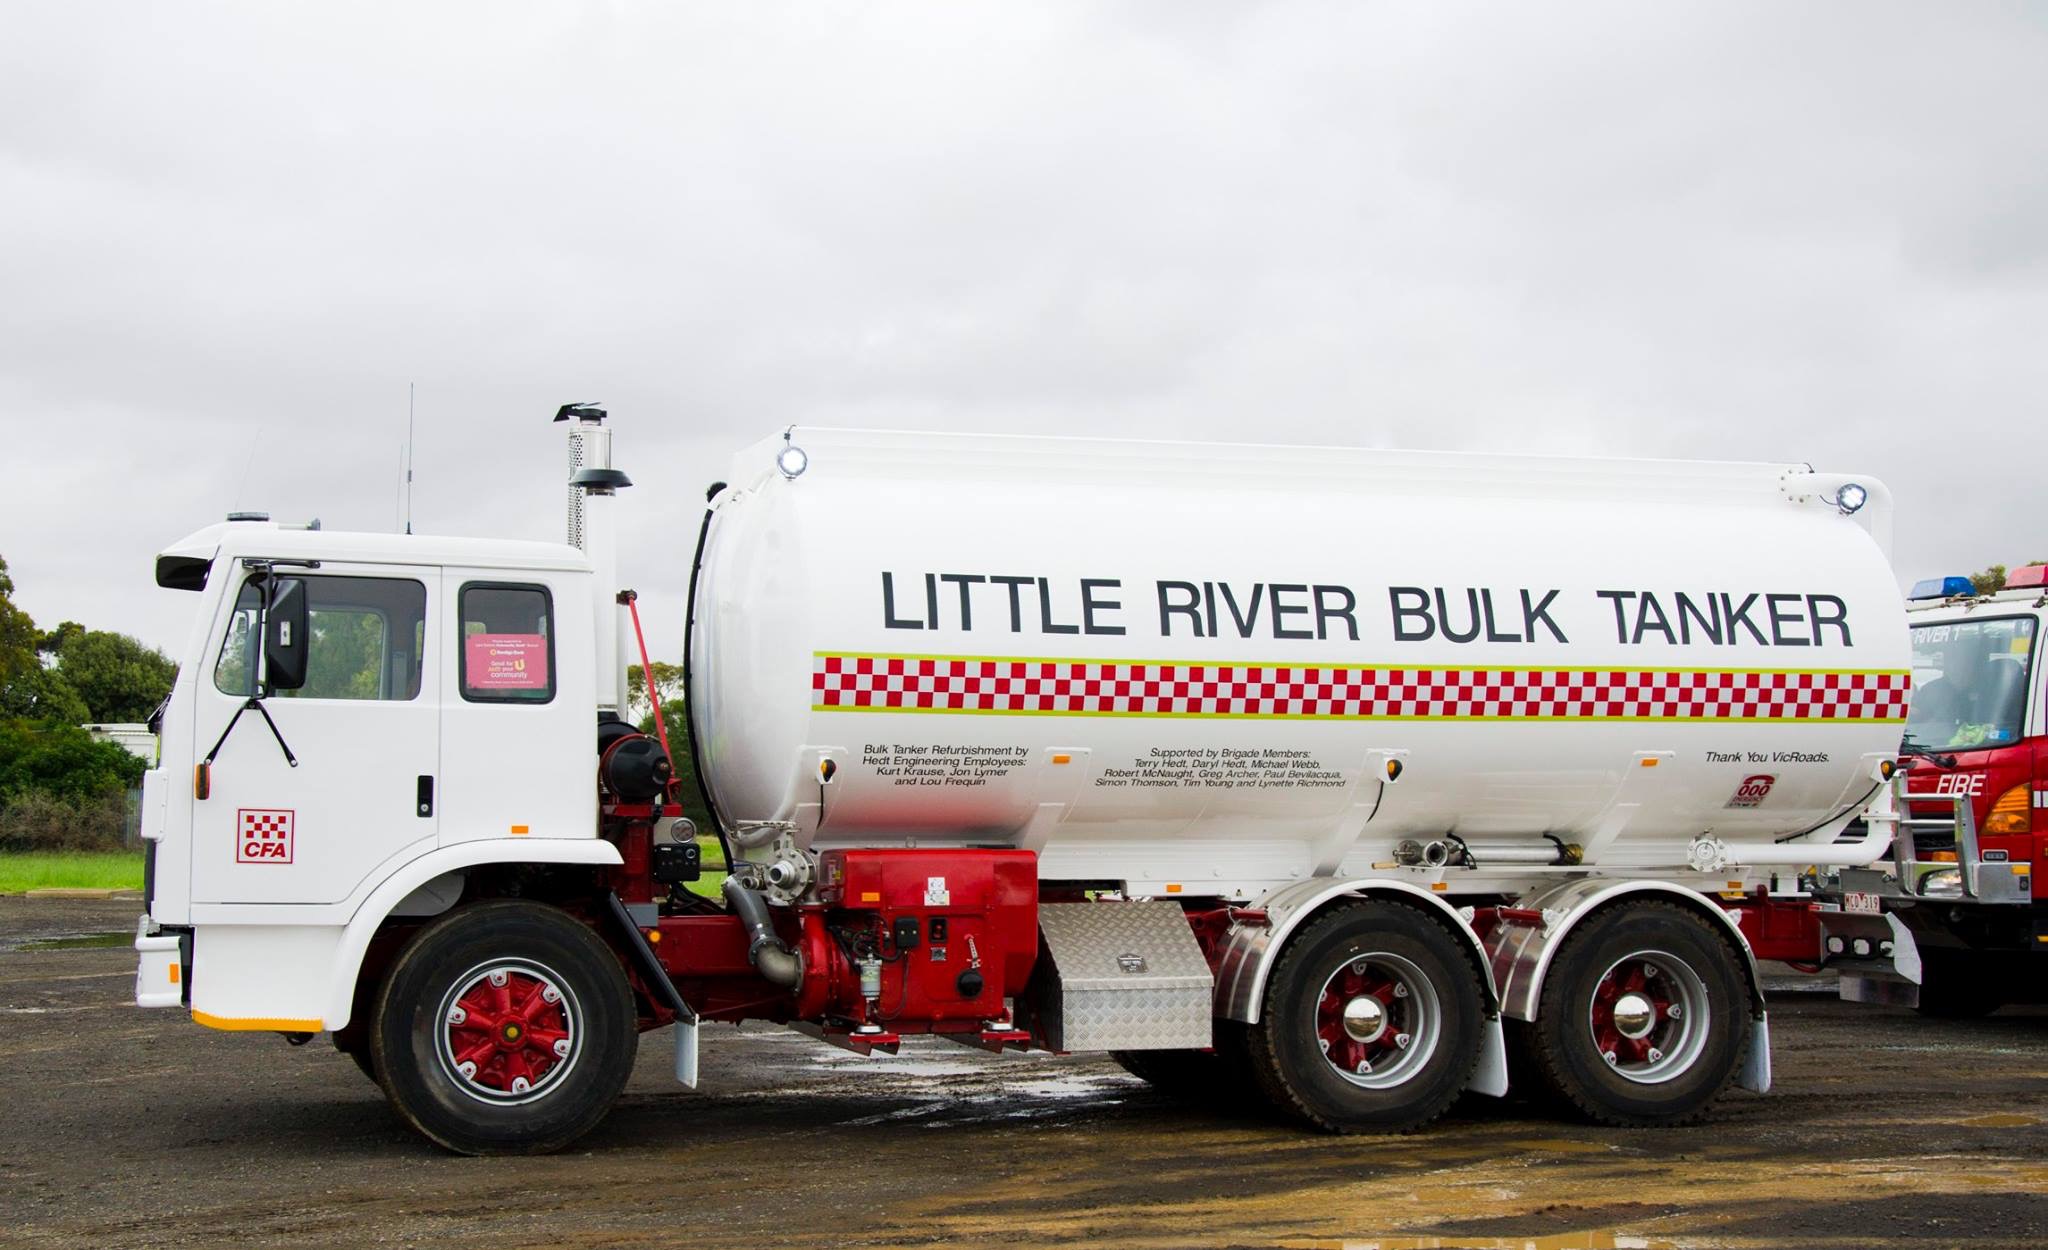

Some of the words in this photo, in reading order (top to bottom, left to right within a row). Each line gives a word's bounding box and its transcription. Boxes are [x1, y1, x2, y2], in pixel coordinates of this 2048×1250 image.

[881, 571, 1127, 635] LITTLE
[1156, 579, 1361, 641] RIVER
[1388, 586, 1570, 644] BULK
[1596, 589, 1854, 647] TANKER
[864, 744, 889, 754] Bulk
[893, 744, 928, 754] Tanker
[931, 745, 1012, 756] Refurbishment
[1015, 746, 1029, 757] by
[1150, 747, 1204, 759] Supported
[1206, 748, 1219, 760] by
[1221, 748, 1260, 760] Brigade
[1262, 749, 1312, 758] Members:
[862, 756, 890, 766] Hedt
[893, 757, 960, 768] Engineering
[963, 757, 1027, 768] Employees:
[1705, 752, 1742, 763] Thank
[1747, 752, 1768, 763] You
[1772, 752, 1830, 763] VicRoads.
[1135, 759, 1159, 769] Terry
[1191, 759, 1219, 769] Daryl
[1250, 760, 1290, 769] Michael
[876, 767, 900, 776] Kurt
[949, 768, 971, 776] Jon
[974, 768, 1008, 778] Lymer
[1104, 768, 1140, 778] Robert
[1198, 769, 1223, 780] Greg
[1263, 770, 1286, 779] Paul
[894, 777, 917, 786] and
[920, 777, 942, 786] Lou
[944, 777, 986, 788] Frequin
[1094, 778, 1128, 787] Simon
[1183, 779, 1202, 788] Tim
[1204, 780, 1234, 789] Young
[1236, 780, 1257, 788] and
[1258, 780, 1295, 789] Lynette
[1296, 780, 1346, 788] Richmond
[1936, 774, 1987, 797] FIRE
[1737, 784, 1771, 797] 000
[244, 842, 286, 858] CFA
